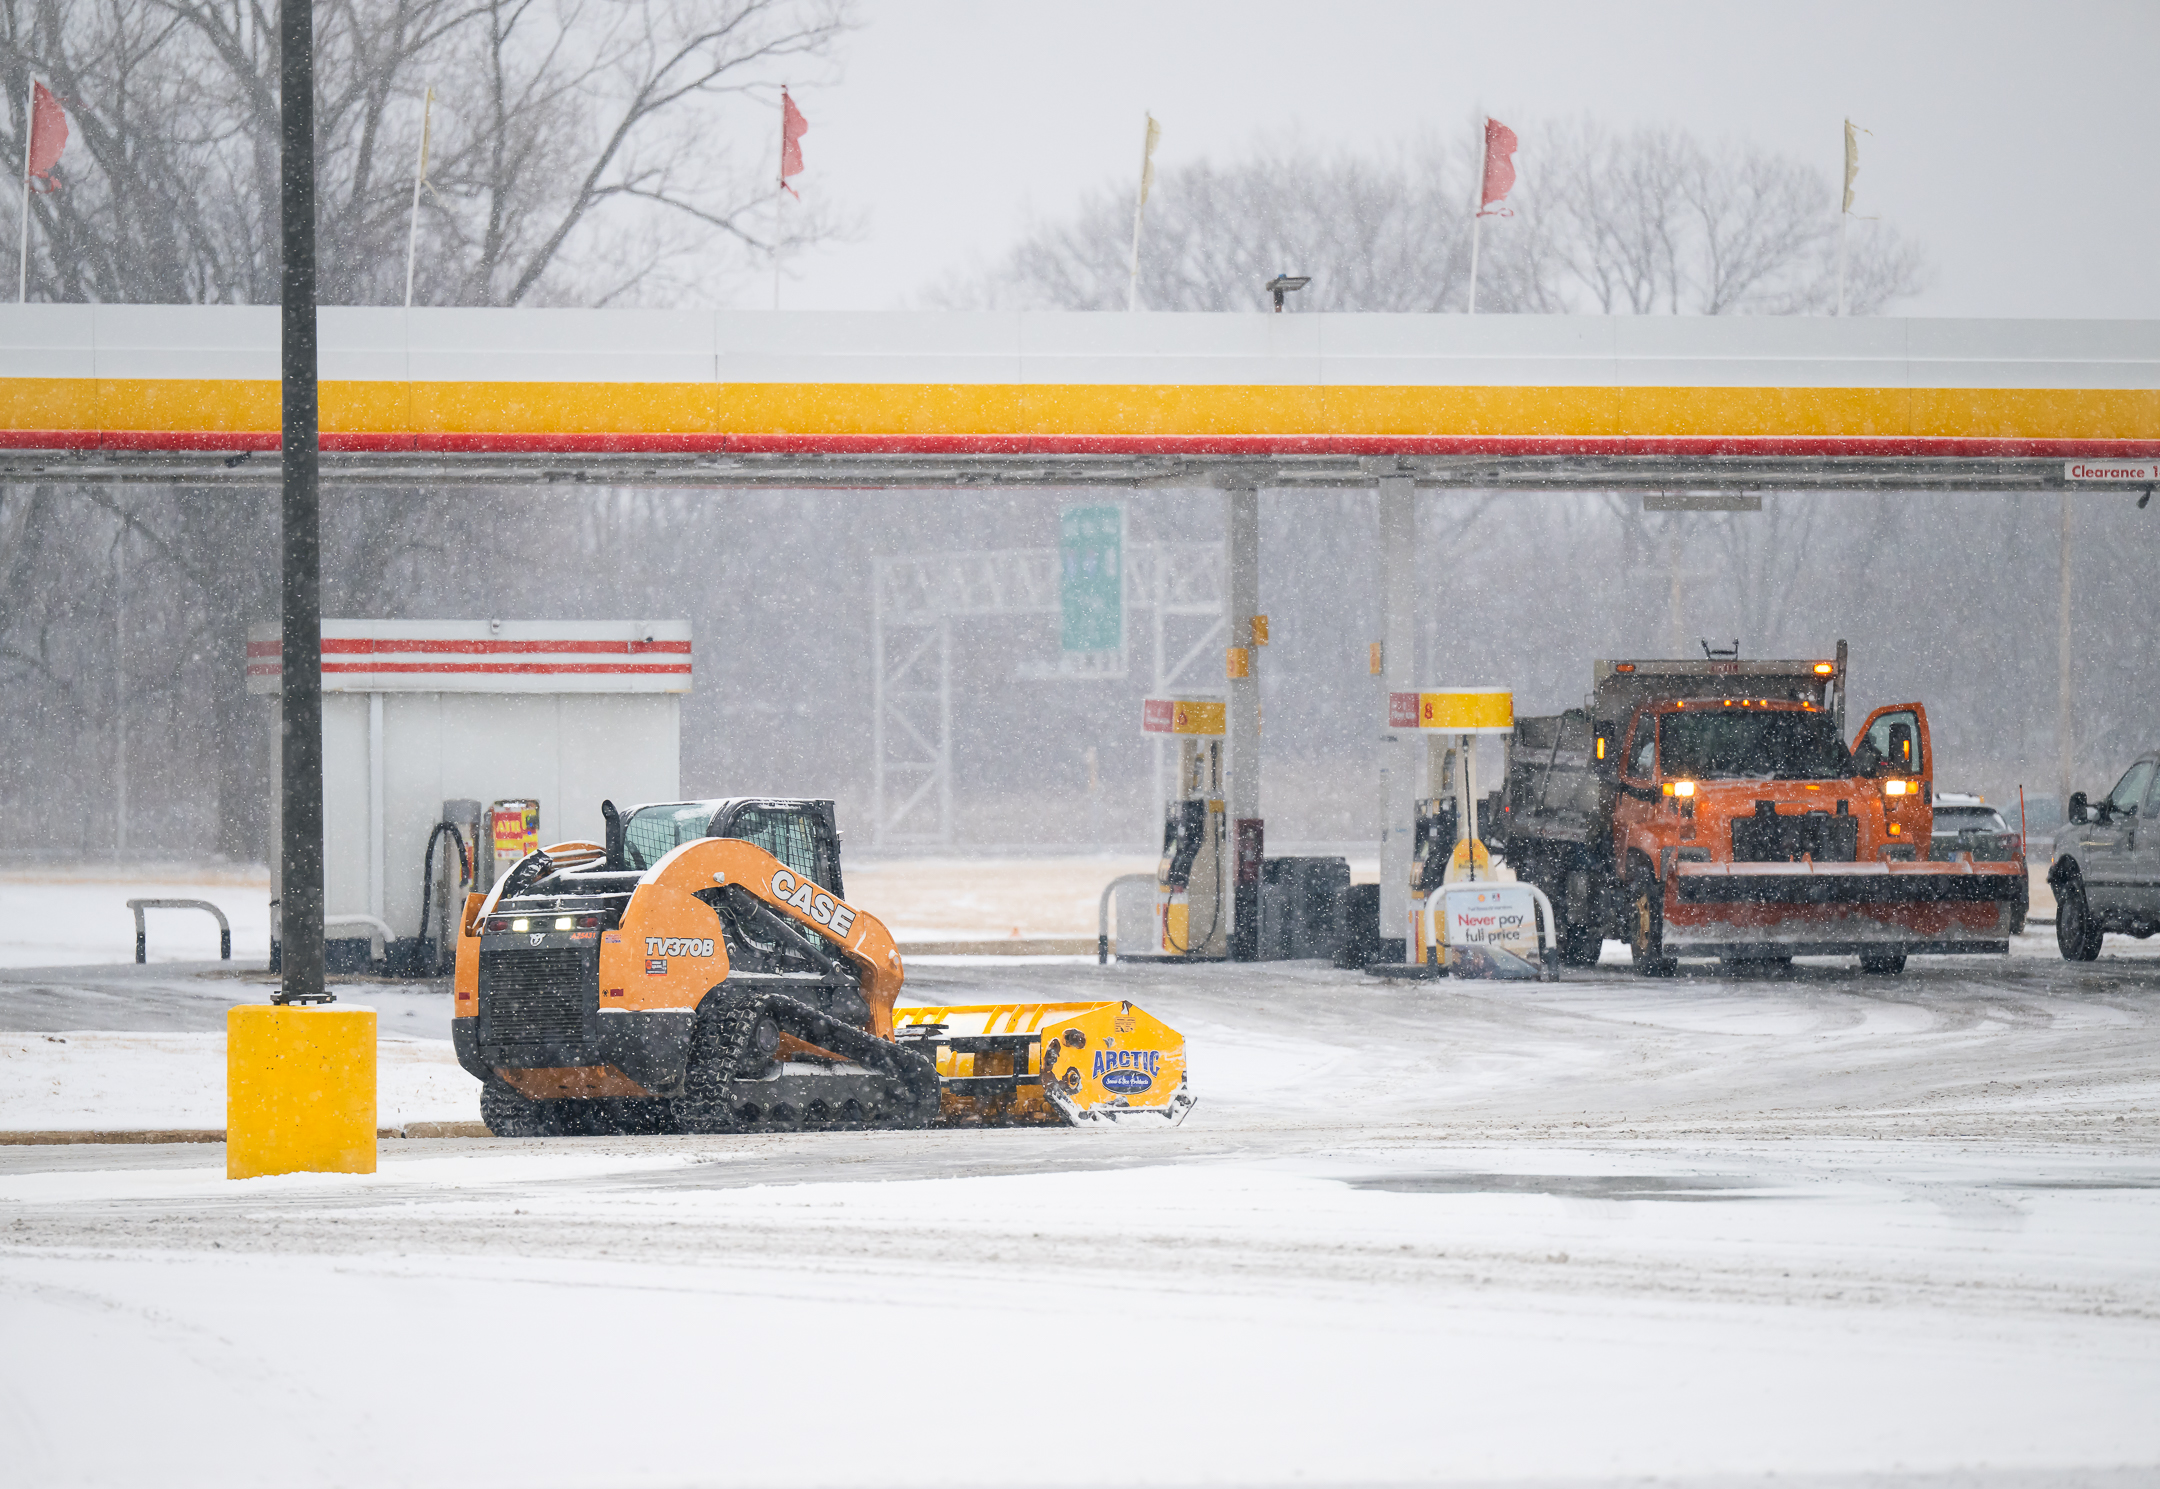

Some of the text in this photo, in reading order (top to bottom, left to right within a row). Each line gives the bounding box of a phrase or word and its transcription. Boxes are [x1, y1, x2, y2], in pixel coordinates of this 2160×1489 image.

[2072, 465, 2160, 478] Clearance 1
[1424, 702, 1433, 720] 8
[496, 820, 521, 833] AIR
[771, 870, 856, 938] CASE
[1458, 914, 1524, 928] Never pay
[1466, 928, 1520, 944] full price
[645, 937, 714, 957] TV370B
[1092, 1050, 1160, 1080] ARCTIC
